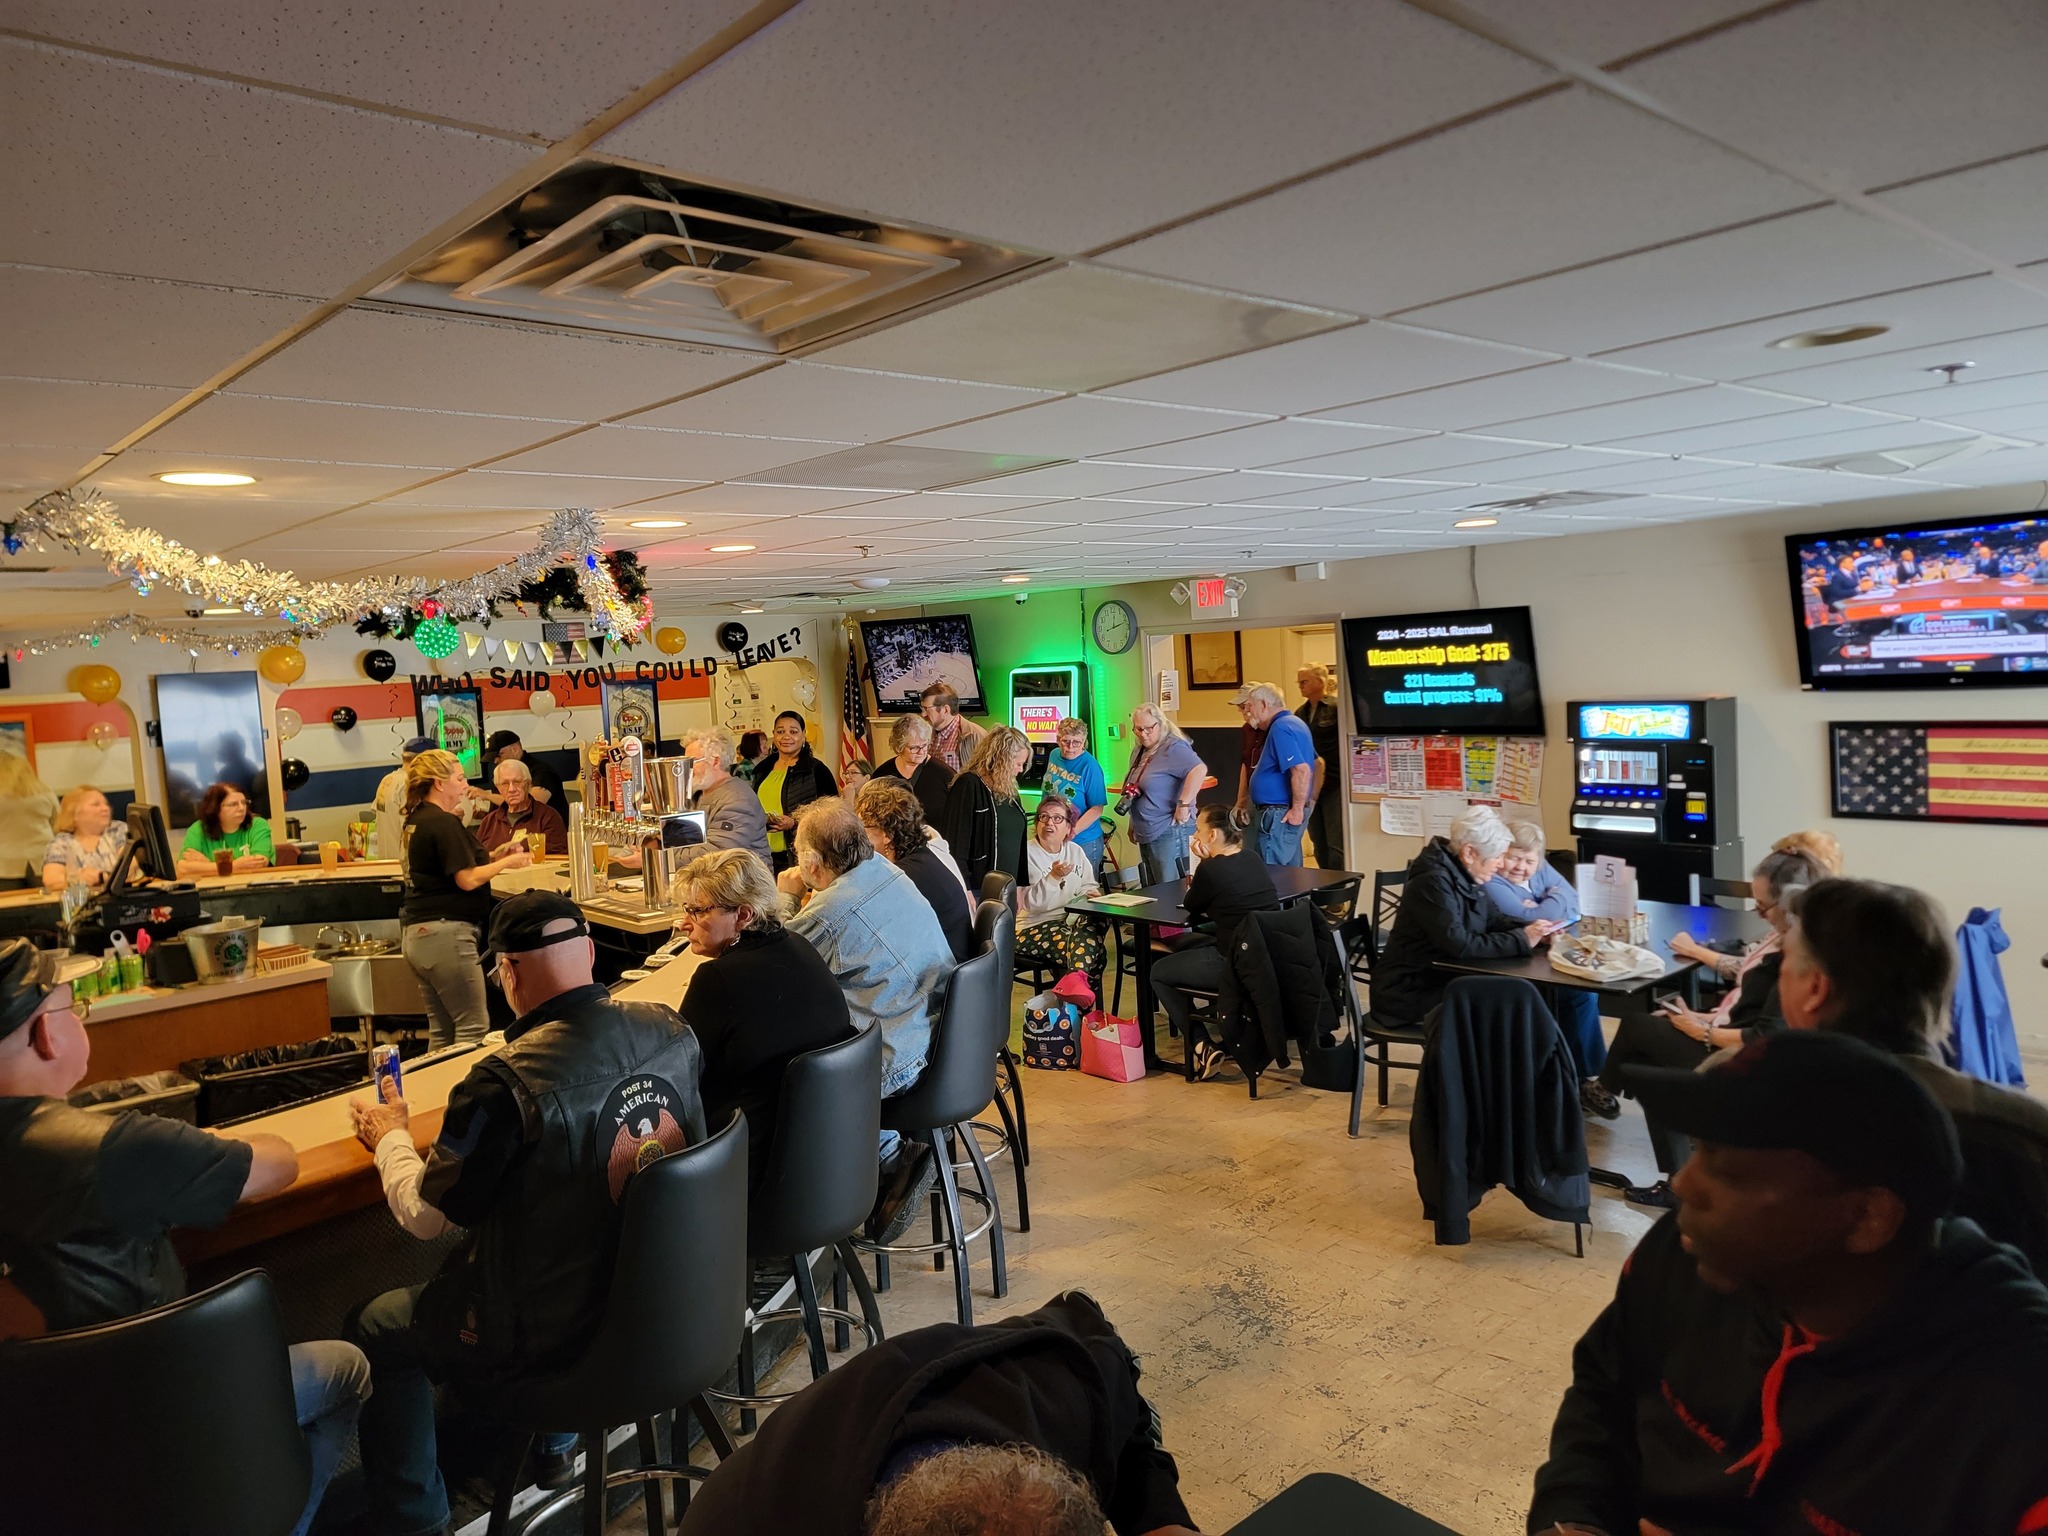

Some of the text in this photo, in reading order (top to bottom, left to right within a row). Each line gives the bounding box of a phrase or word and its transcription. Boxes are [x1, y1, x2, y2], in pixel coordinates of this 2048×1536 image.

[1197, 580, 1225, 607] EXIT
[1110, 606, 1116, 614] 12
[1377, 630, 1400, 640] 2024
[1405, 628, 1428, 639] 2025
[1428, 626, 1449, 637] SAL
[410, 627, 801, 695] WHO SAID YOU COULD LEAVE?
[1367, 642, 1510, 666] Membership Goal: 375
[1423, 672, 1475, 687] Renewals
[1384, 688, 1503, 706] Current progress: 91%
[1022, 708, 1052, 717] THERE'S
[1026, 721, 1058, 730] NO WAIT
[446, 740, 463, 748] RMY
[1605, 863, 1615, 878] 5
[621, 1080, 652, 1098] POST 34
[614, 1092, 669, 1127] AMERICAN
